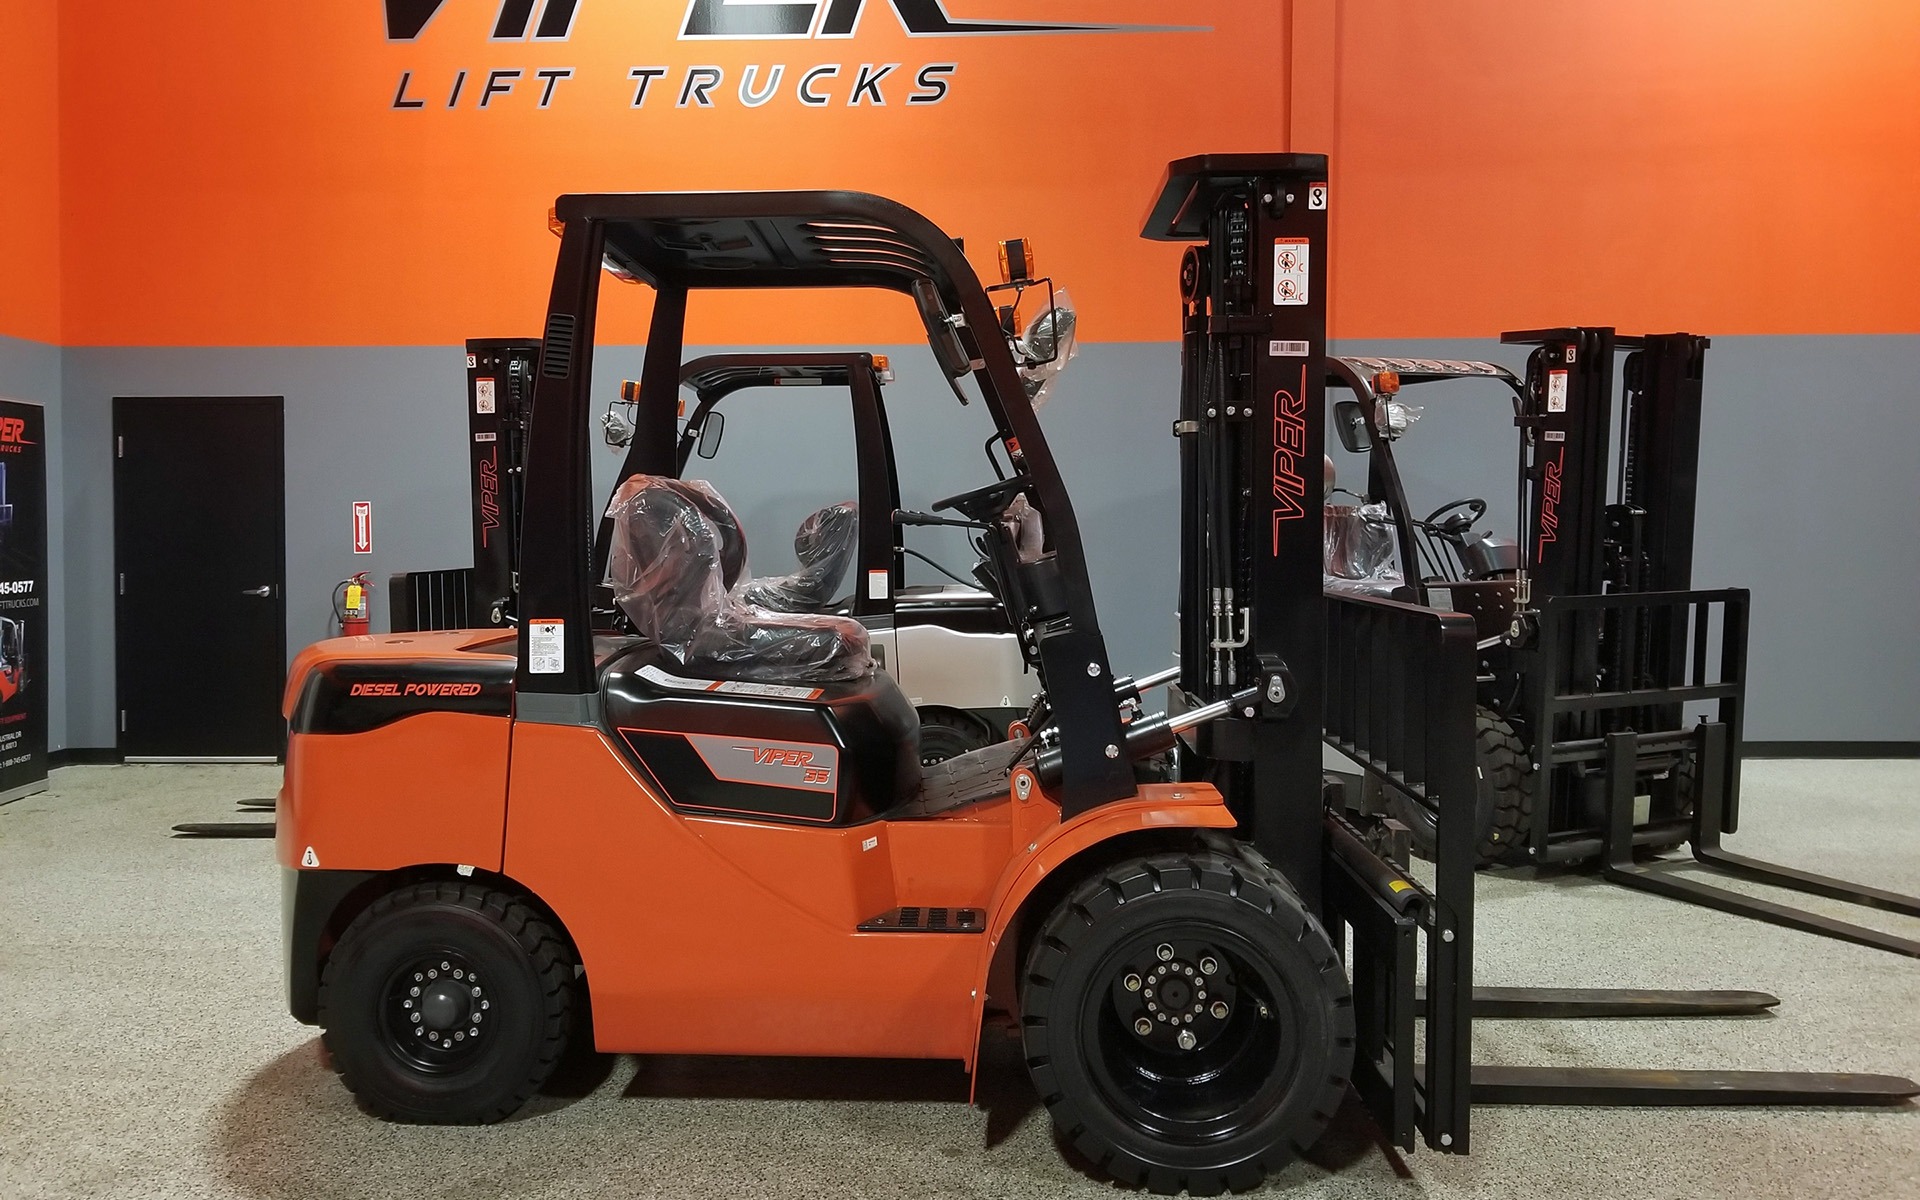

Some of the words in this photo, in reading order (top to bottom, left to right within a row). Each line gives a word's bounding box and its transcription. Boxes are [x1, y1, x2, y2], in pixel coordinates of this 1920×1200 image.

[391, 67, 576, 110] LIFT
[627, 62, 958, 110] TRUCKS
[0, 417, 38, 444] ER
[1273, 364, 1307, 556] VIPER
[480, 446, 499, 548] VIPER
[1538, 446, 1564, 563] VIPER
[350, 683, 401, 696] DIESEL
[404, 683, 481, 696] POWERED
[732, 746, 831, 770] VIPER
[803, 769, 830, 784] 35
